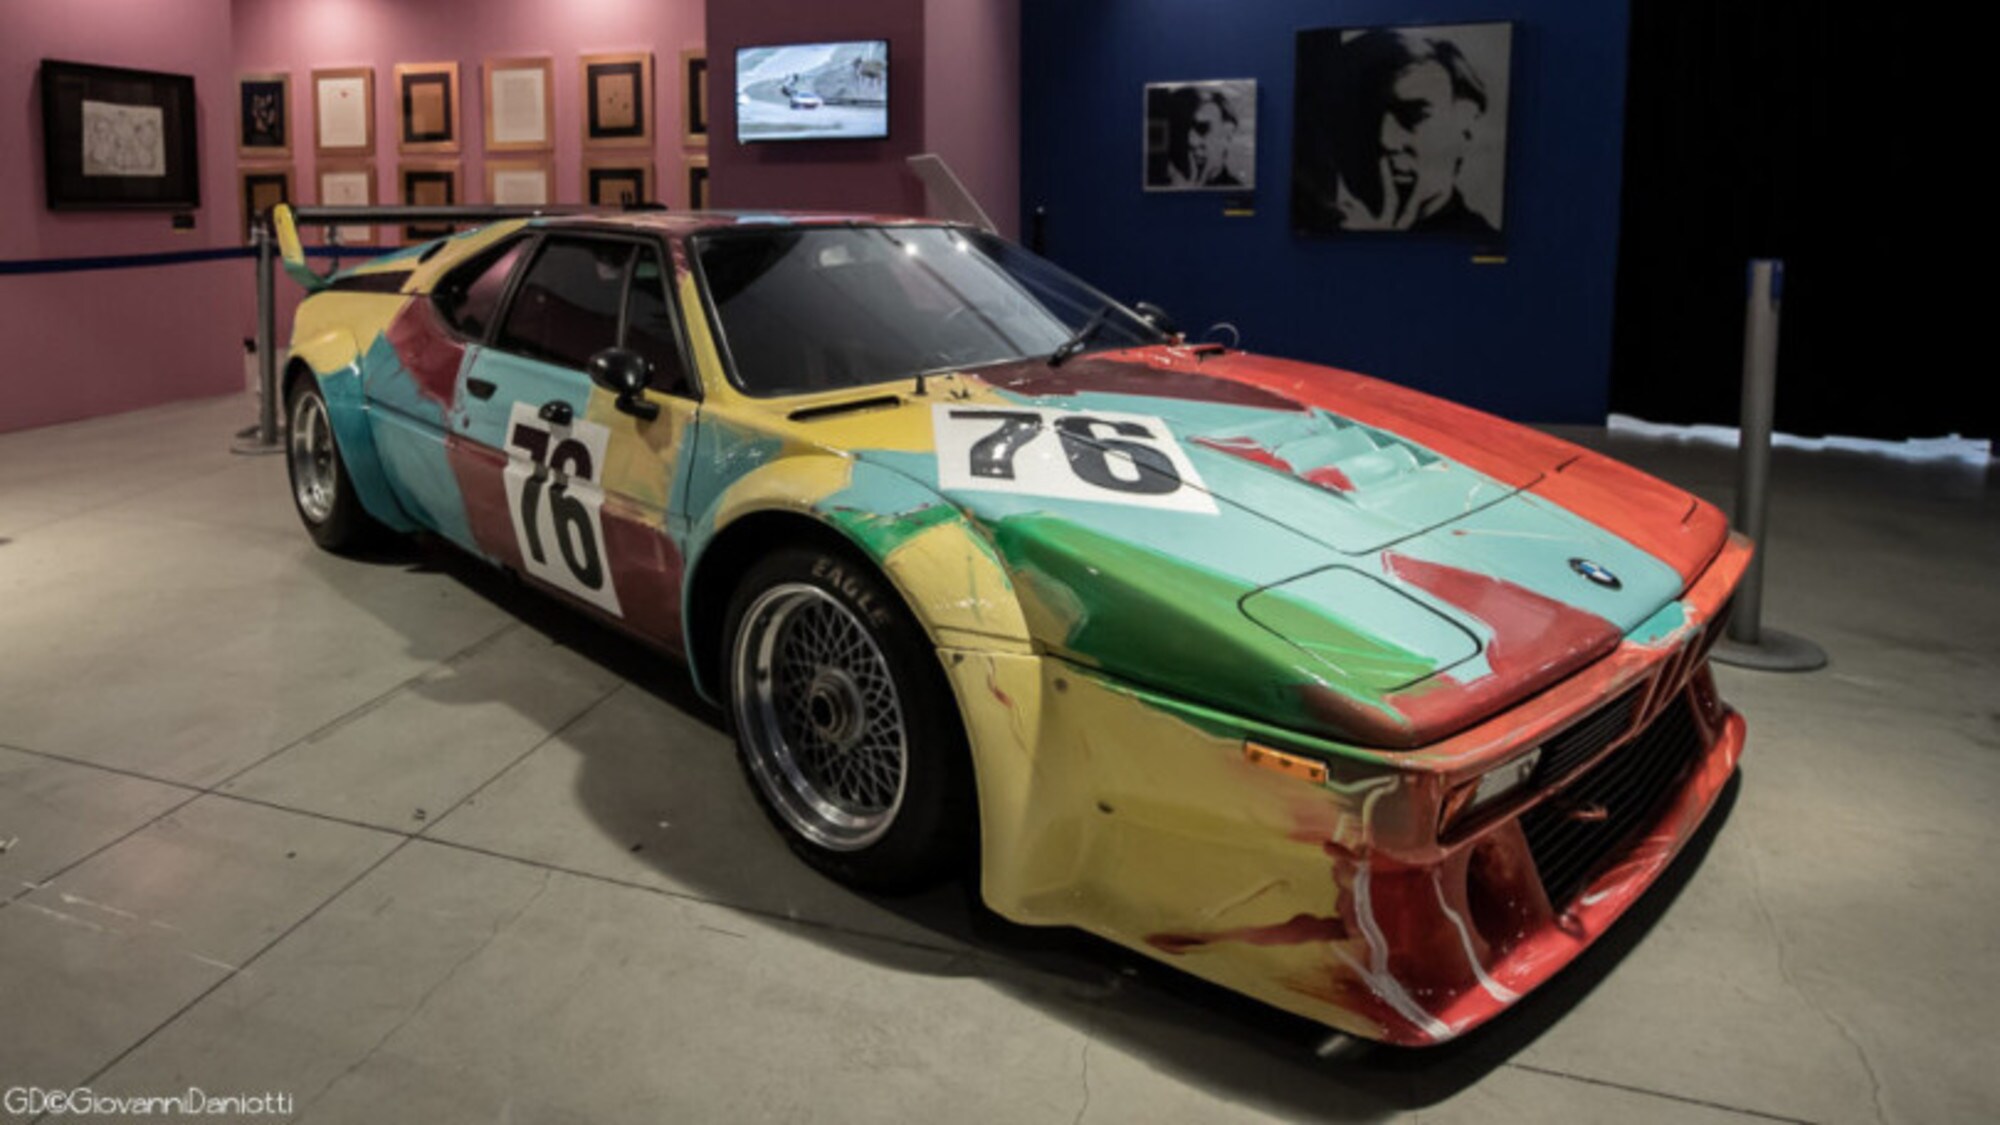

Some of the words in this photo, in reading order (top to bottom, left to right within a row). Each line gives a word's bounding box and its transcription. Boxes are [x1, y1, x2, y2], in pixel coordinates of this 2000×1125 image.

[949, 410, 1182, 496] 76
[511, 423, 604, 590] 76
[811, 556, 890, 628] EAGLE
